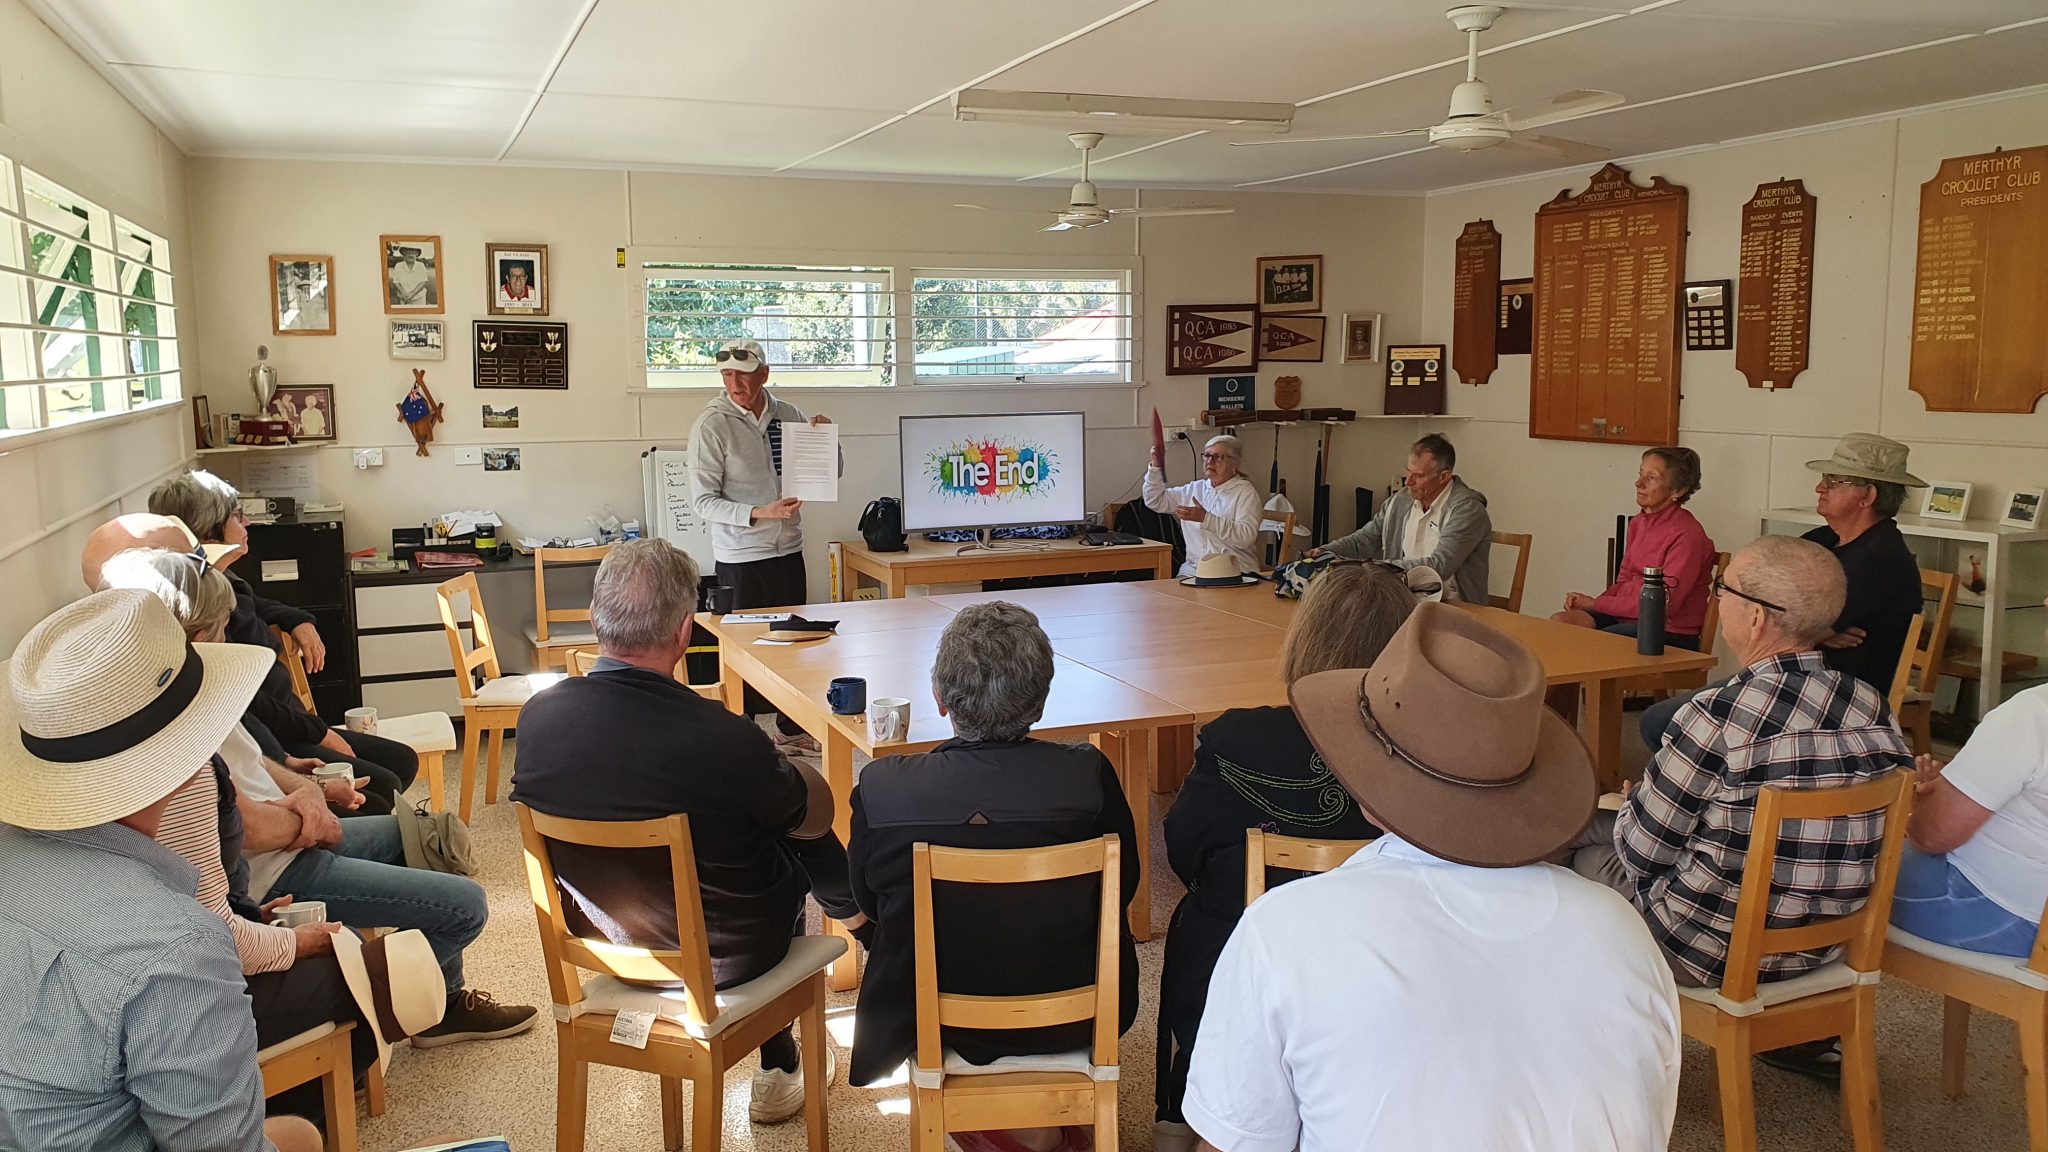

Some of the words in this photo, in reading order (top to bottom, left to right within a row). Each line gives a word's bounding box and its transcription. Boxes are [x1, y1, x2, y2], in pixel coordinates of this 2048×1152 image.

[1963, 155, 2021, 176] MERTHYR
[1593, 181, 1622, 192] MERTHYR
[1941, 176, 2000, 196] CROQUET
[2007, 171, 2041, 187] CLUB
[1583, 191, 1610, 203] CROQUET
[1614, 189, 1630, 199] CLUB
[1762, 186, 1796, 198] MERTHYR
[1960, 191, 2024, 207] PRESIDENTS
[1753, 197, 1780, 208] CROQUET
[1784, 195, 1802, 205] CLUB
[1782, 210, 1804, 218] EVENTS
[1185, 320, 1215, 337] QCA
[1220, 323, 1237, 331] 1985
[1272, 331, 1295, 341] QCA
[1183, 345, 1213, 361] QCA
[948, 455, 990, 487] The
[995, 452, 1039, 486] End
